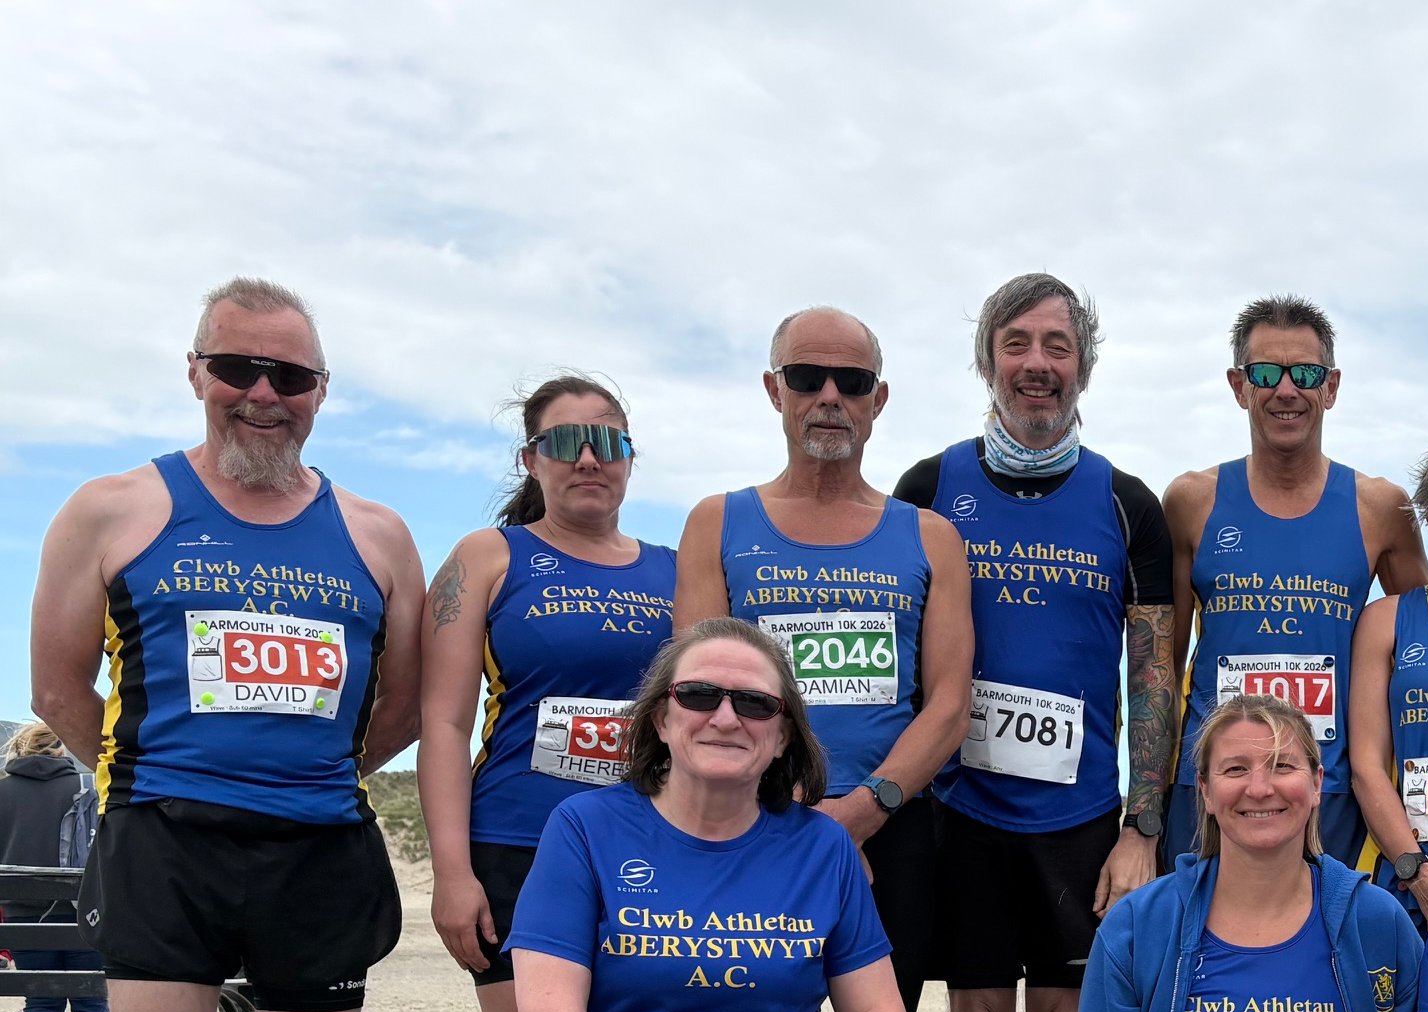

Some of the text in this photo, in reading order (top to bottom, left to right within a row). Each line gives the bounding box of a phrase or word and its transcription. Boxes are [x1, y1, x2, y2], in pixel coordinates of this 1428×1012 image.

[1008, 541, 1098, 566] Athletau
[173, 559, 352, 591] Clwb Athletau
[756, 566, 898, 585] Clwb Athletau
[1215, 572, 1349, 598] Clwb Athletau
[542, 585, 599, 598] Clwb
[743, 587, 912, 612] ABERYSTWYTH
[996, 586, 1047, 606] A.C.
[241, 597, 294, 617] A.C.
[280, 625, 301, 636] 10K
[305, 628, 331, 639] 20
[601, 618, 652, 635] A.C.
[771, 620, 886, 633] BARMOUTH 10K 2026
[1257, 617, 1303, 635] A.C.
[231, 638, 340, 680] 3013
[798, 637, 893, 670] 2046
[1228, 661, 1326, 672] BARMOUTH 10K 2026
[235, 684, 307, 702] DAVID
[799, 678, 871, 695] DAMIAN
[1253, 676, 1331, 709] 1017
[552, 705, 615, 716] BARMOUTH
[976, 688, 1076, 714] BARMOUTH 10K 2026
[575, 721, 629, 753] 33
[995, 708, 1074, 750] 7081
[618, 907, 815, 933] Clwb Athletau
[685, 965, 756, 989] A.C.
